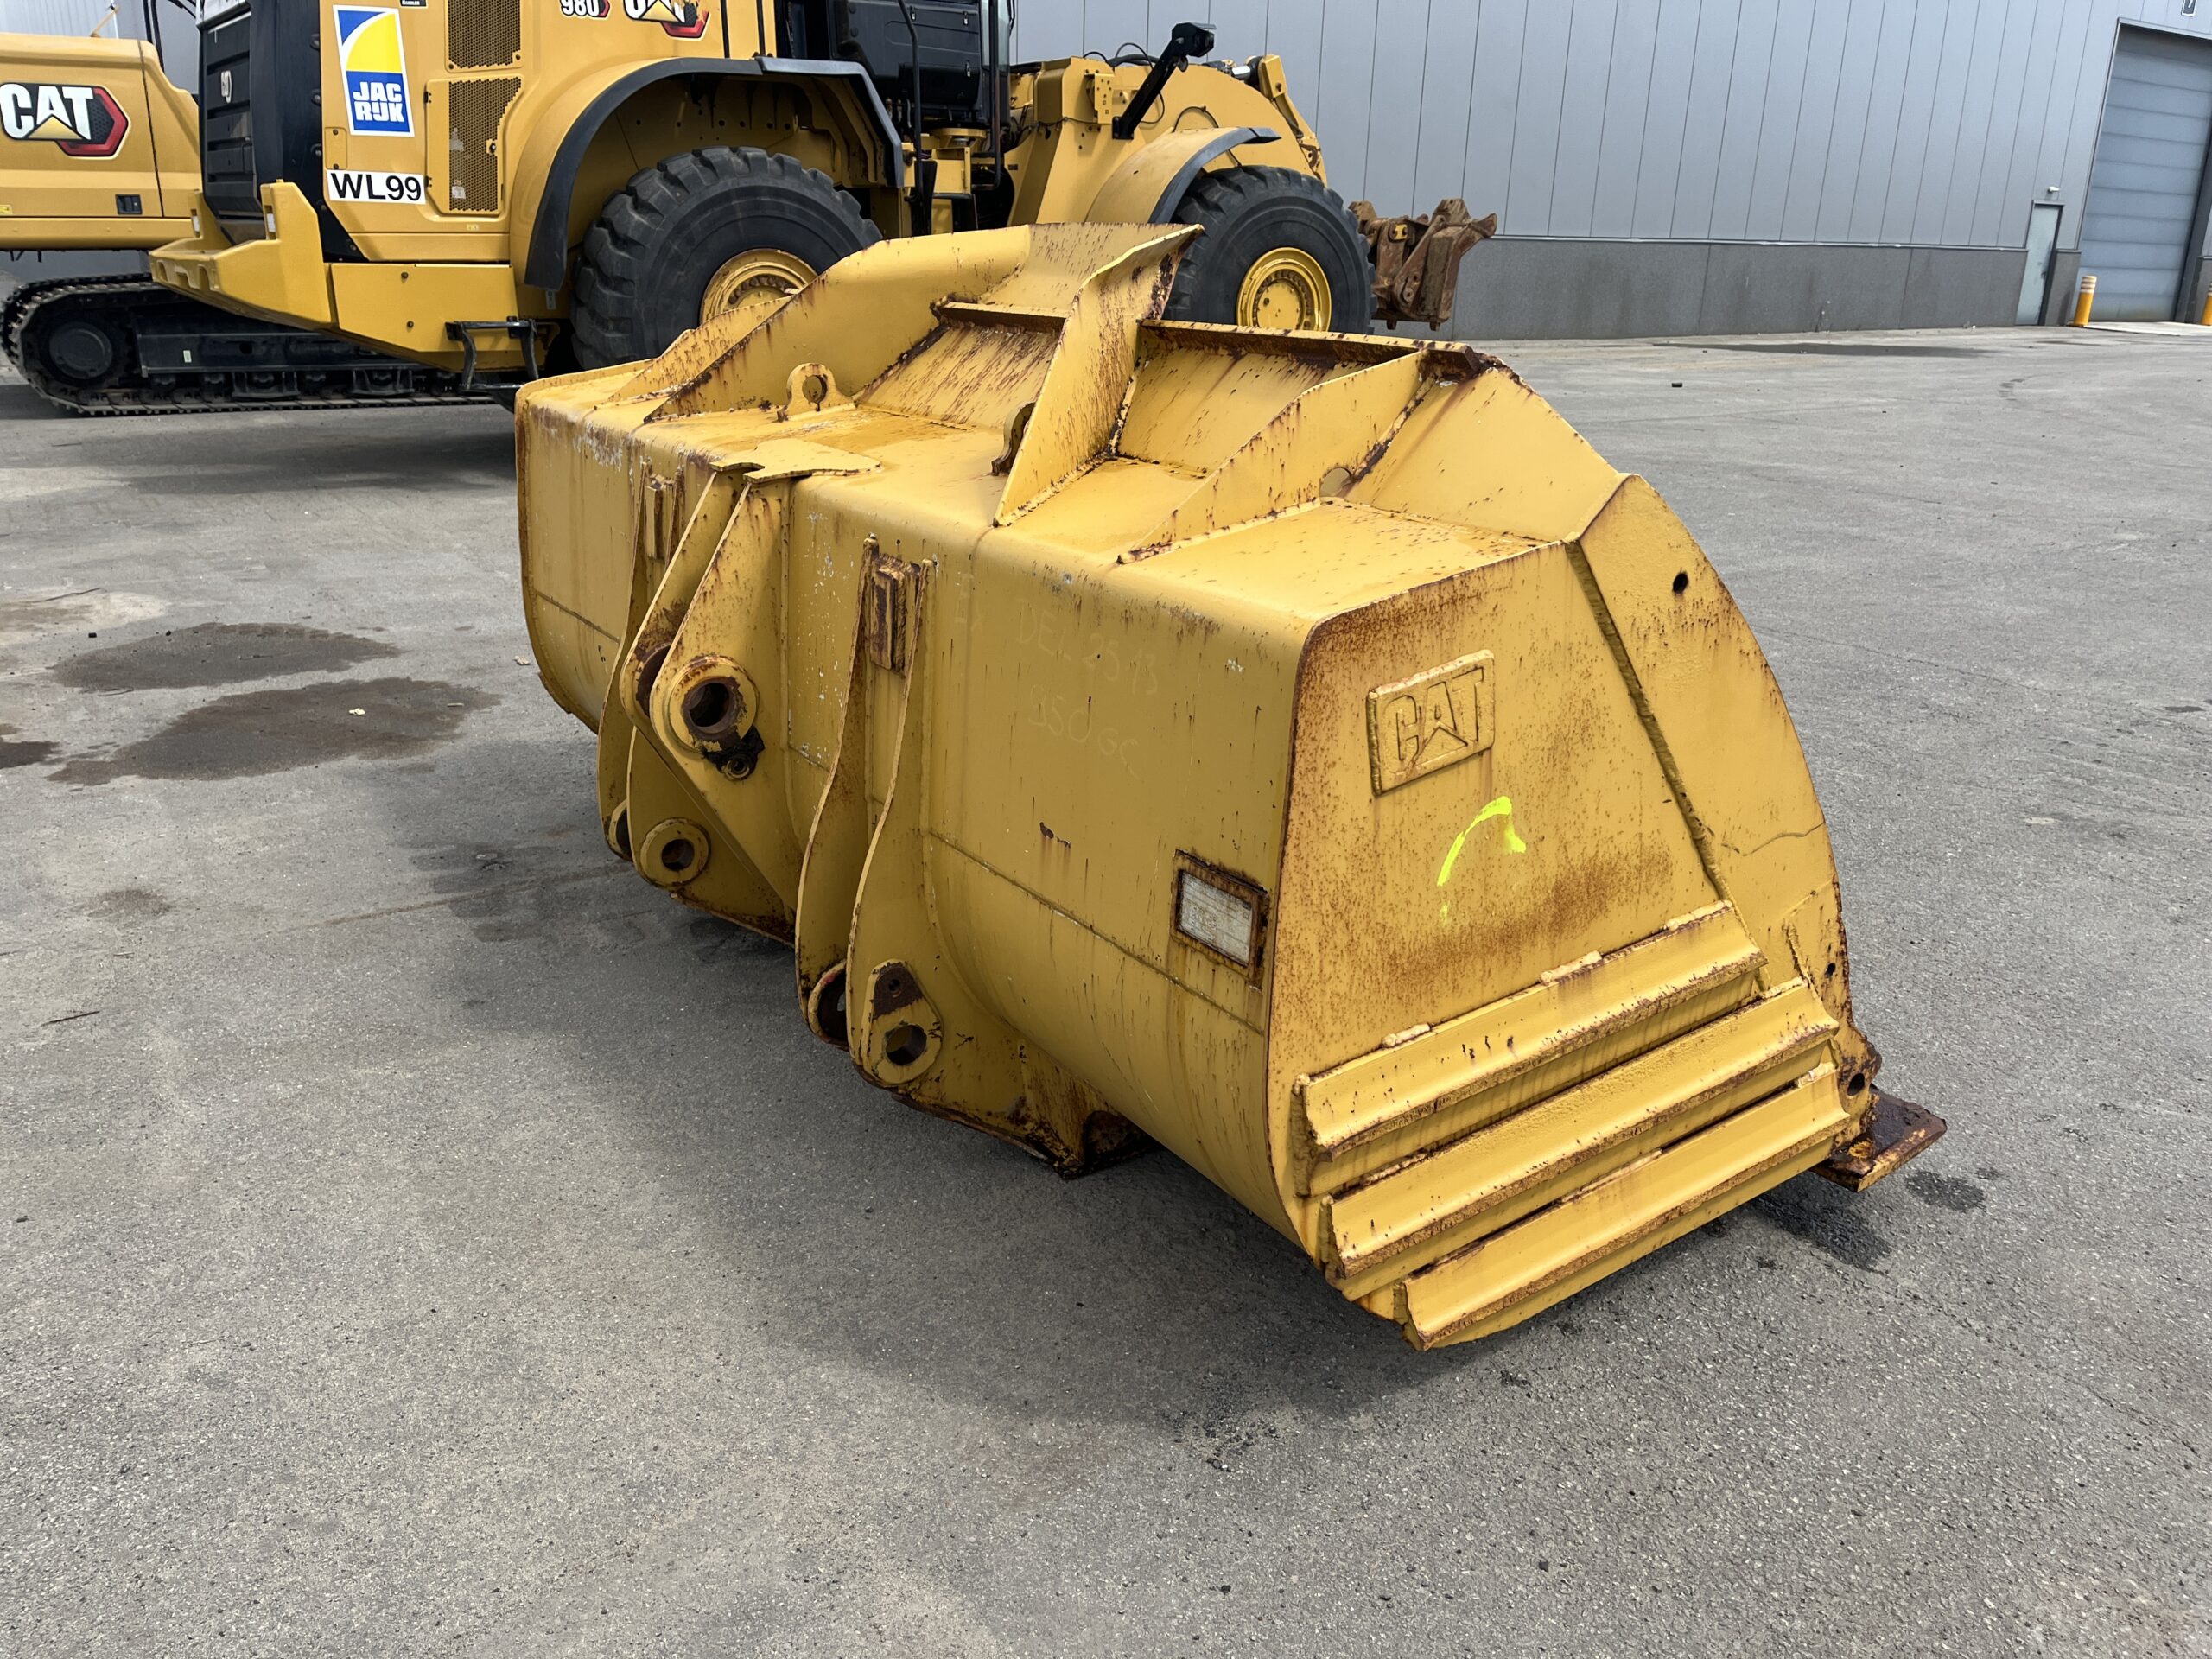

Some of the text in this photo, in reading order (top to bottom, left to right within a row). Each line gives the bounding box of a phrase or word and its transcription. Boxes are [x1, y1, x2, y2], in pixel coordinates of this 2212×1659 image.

[561, 0, 600, 16] 980
[353, 81, 403, 102] JAC
[0, 84, 93, 140] CAT
[330, 172, 422, 201] WL99
[1383, 666, 1484, 776] CAT
